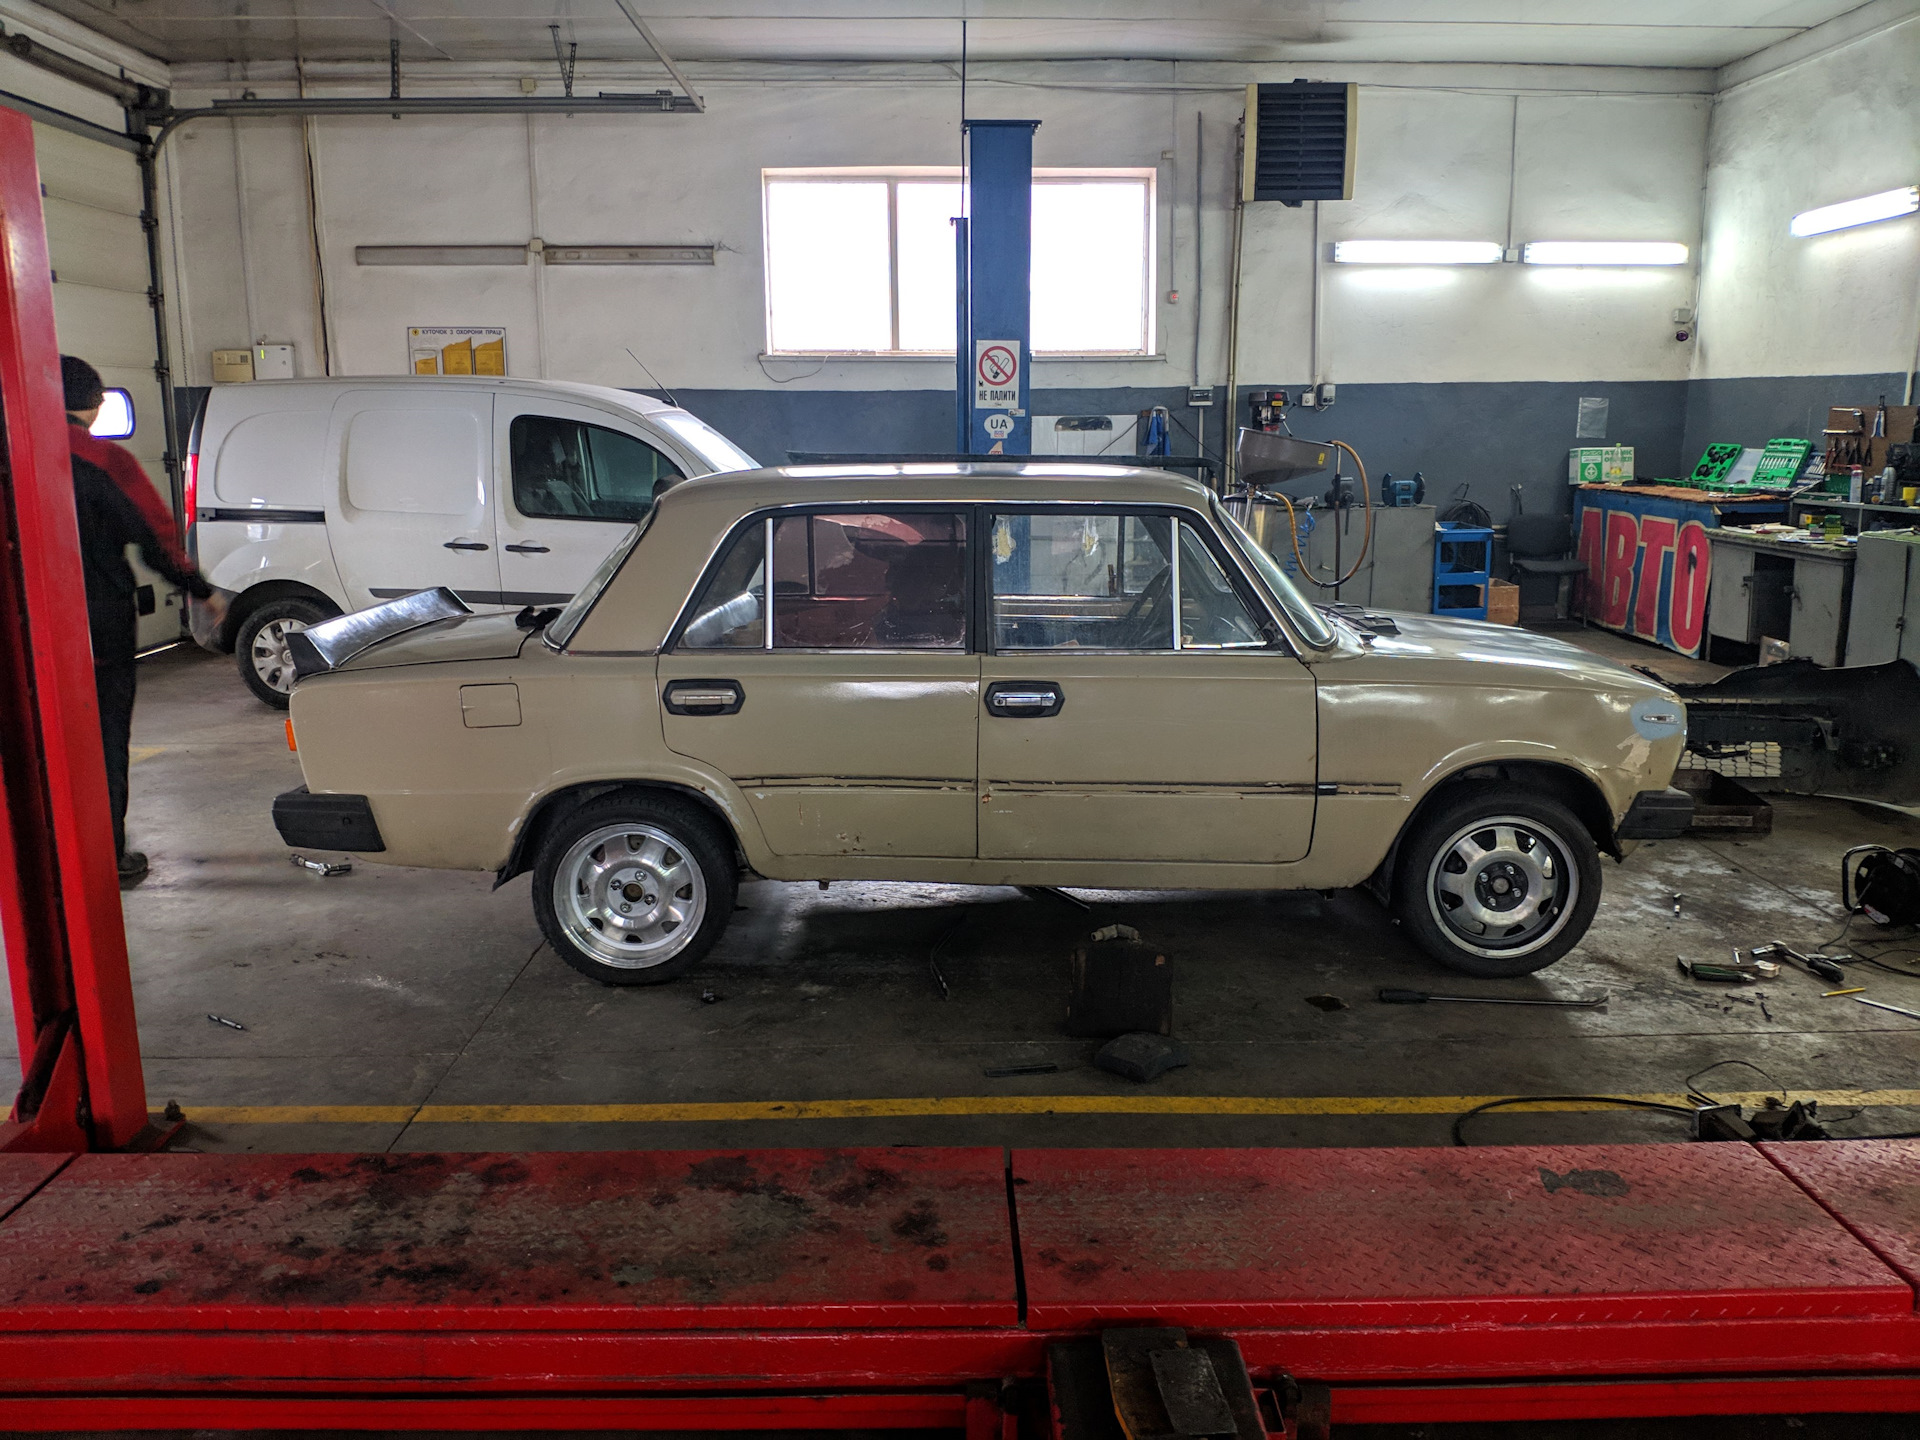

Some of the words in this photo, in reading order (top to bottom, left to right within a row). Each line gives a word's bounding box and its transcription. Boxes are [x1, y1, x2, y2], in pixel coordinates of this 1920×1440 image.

[979, 390, 988, 401] НЕ
[990, 390, 1016, 401] ПАЛИТИ
[990, 419, 1008, 429] UA
[1573, 506, 1712, 654] АВТО
